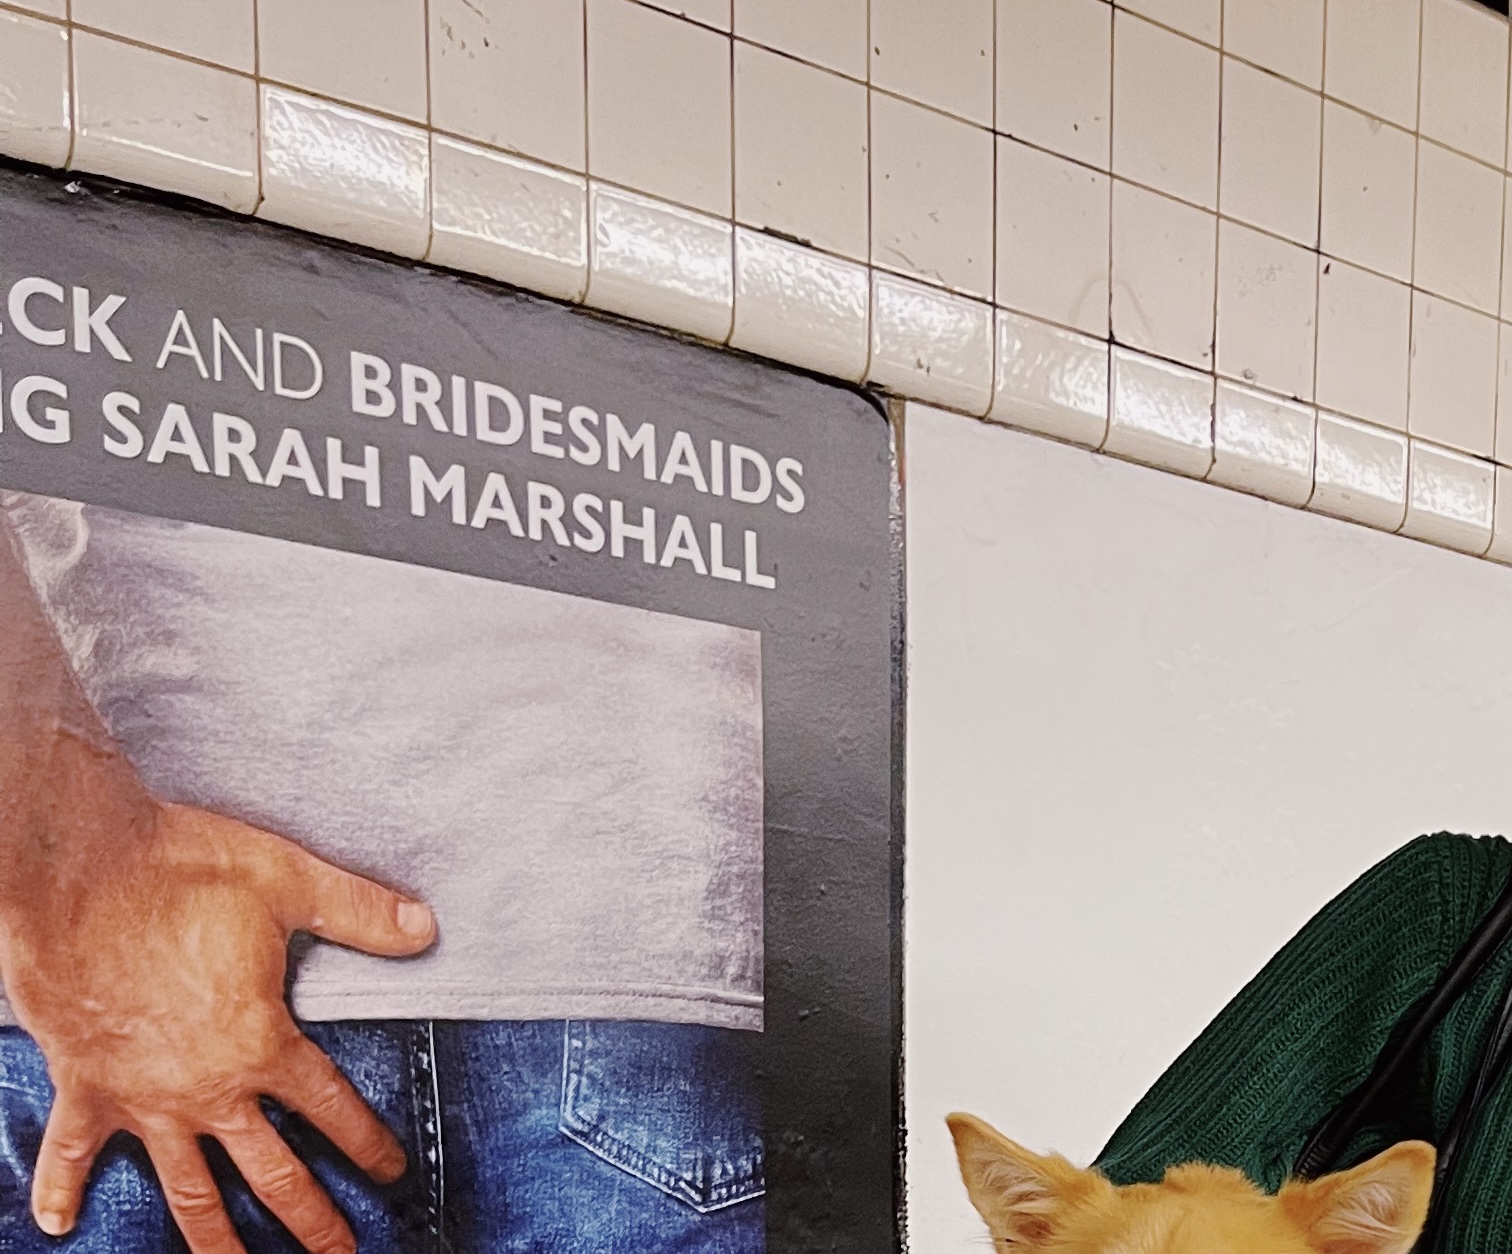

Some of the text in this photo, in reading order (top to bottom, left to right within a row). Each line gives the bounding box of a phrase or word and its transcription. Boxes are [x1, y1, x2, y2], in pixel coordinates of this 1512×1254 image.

[0, 276, 804, 513] CK AND BRIDESMAIDS
[0, 367, 777, 589] G SARAH MARSHALL
